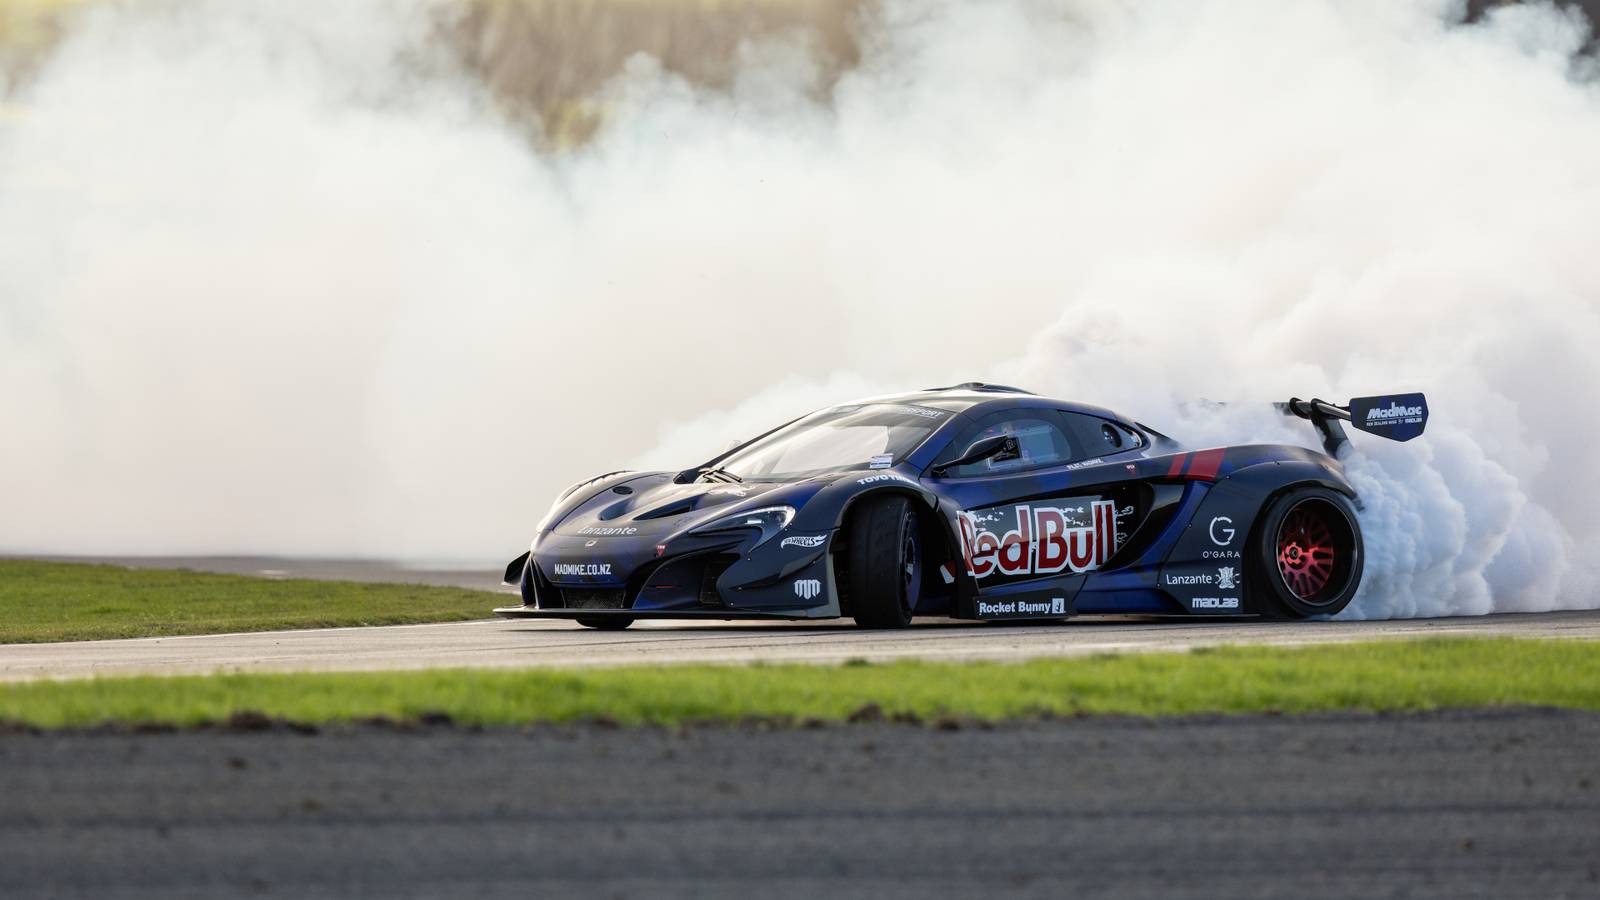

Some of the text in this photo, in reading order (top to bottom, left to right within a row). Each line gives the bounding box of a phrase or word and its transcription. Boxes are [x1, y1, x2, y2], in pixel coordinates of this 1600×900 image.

[1367, 402, 1422, 419] MadMac
[856, 474, 889, 485] TOYO
[577, 525, 638, 535] Lanzante
[1034, 499, 1117, 573] Bull
[554, 563, 612, 575] MADMIKE.CO.NZ
[1166, 573, 1213, 585] Lanzante
[979, 601, 1051, 614] Rocket Bunny
